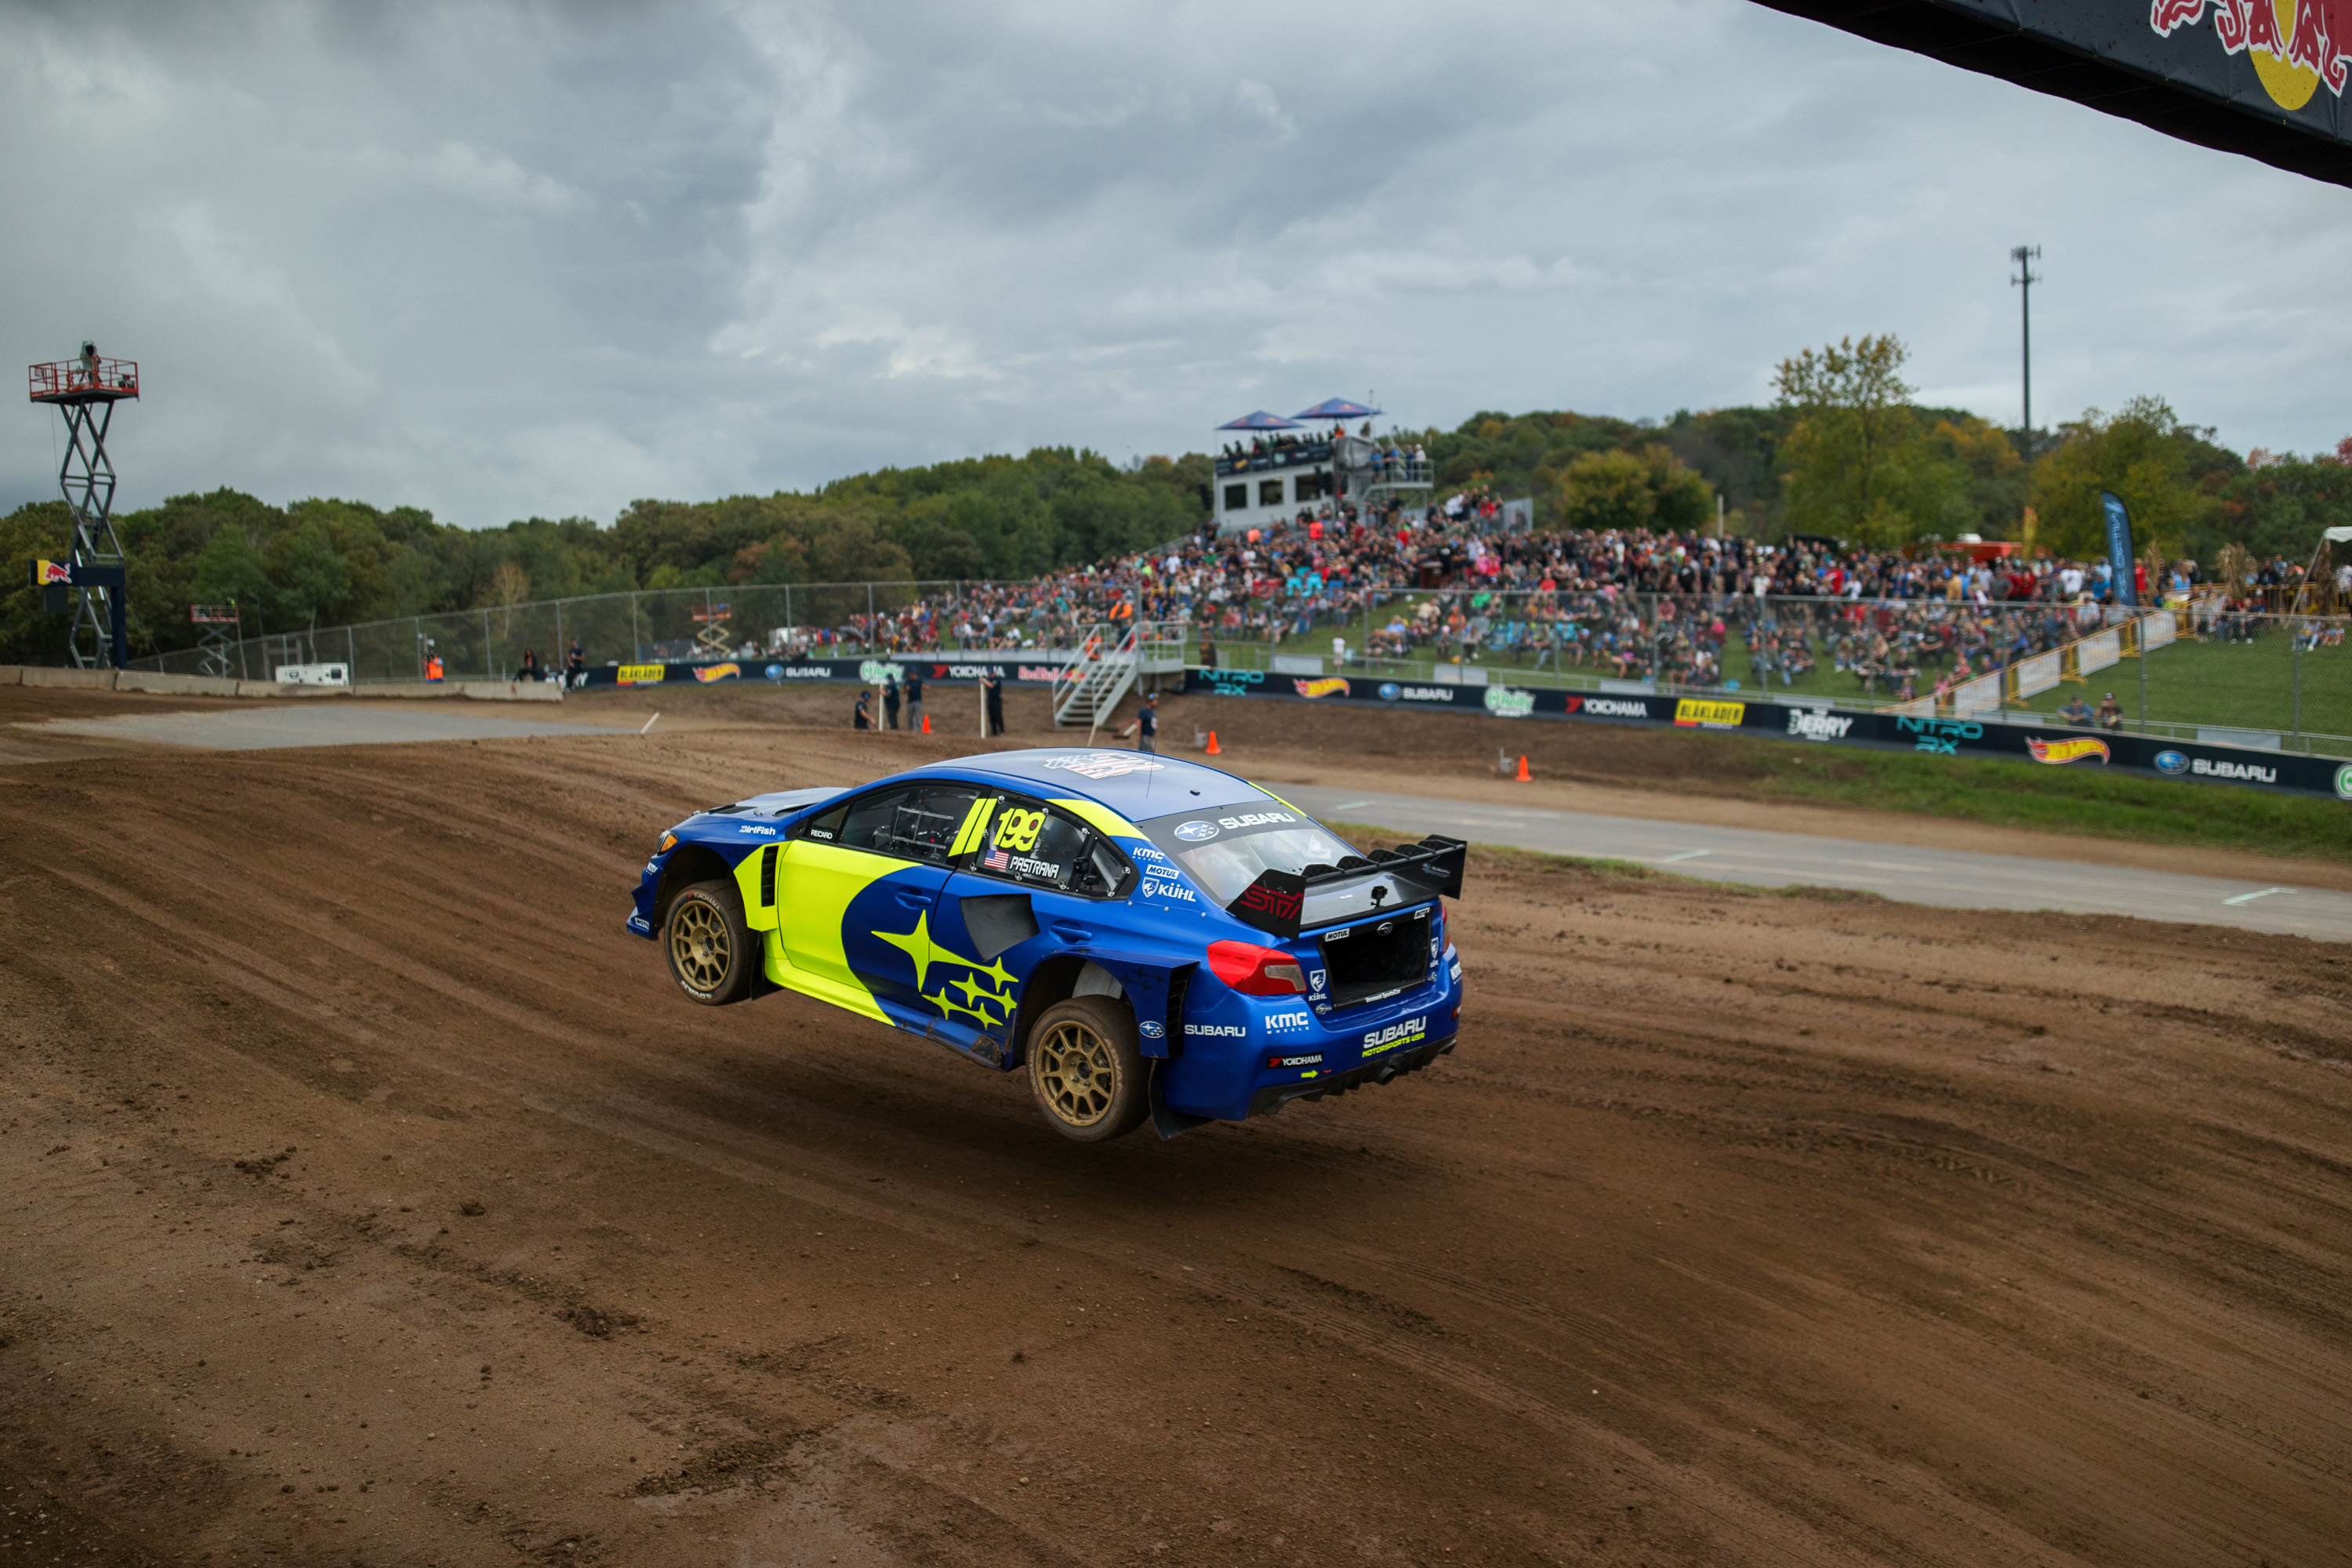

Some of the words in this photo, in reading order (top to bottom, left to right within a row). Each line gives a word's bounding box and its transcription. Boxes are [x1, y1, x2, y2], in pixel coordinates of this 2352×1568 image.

[784, 666, 829, 677] SUBARU
[1018, 666, 1039, 681] Red
[1199, 670, 1264, 684] NITRO
[1215, 683, 1247, 696] RX
[1403, 688, 1453, 701] SUBARU
[1584, 699, 1647, 717] YOKOHAMA
[1896, 715, 1984, 739] NITRO
[1916, 735, 1958, 755] RX
[2192, 757, 2277, 783] SUBARU
[993, 808, 1047, 851] 199
[1218, 812, 1296, 830] SUBARU
[811, 829, 833, 840] RECARO
[1010, 855, 1060, 879] PASTRANA
[1148, 866, 1177, 878] MOTUL
[1158, 883, 1196, 902] KÜHL
[693, 892, 720, 912] YOKOHAMA
[1326, 929, 1348, 940] MOTUL
[681, 979, 713, 1000] ADVAN
[1308, 993, 1327, 1002] KÜHL
[1265, 1011, 1308, 1029] KMC
[1185, 1025, 1246, 1037] SUBARU
[1267, 1026, 1309, 1035] WHEELS
[1363, 1016, 1427, 1049] SUBARU
[1362, 1036, 1410, 1058] MOTORSPORTS
[1411, 1032, 1425, 1042] USA
[1282, 1054, 1323, 1066] YOKOHAMA
[1029, 1050, 1040, 1095] YOKOHAMA
